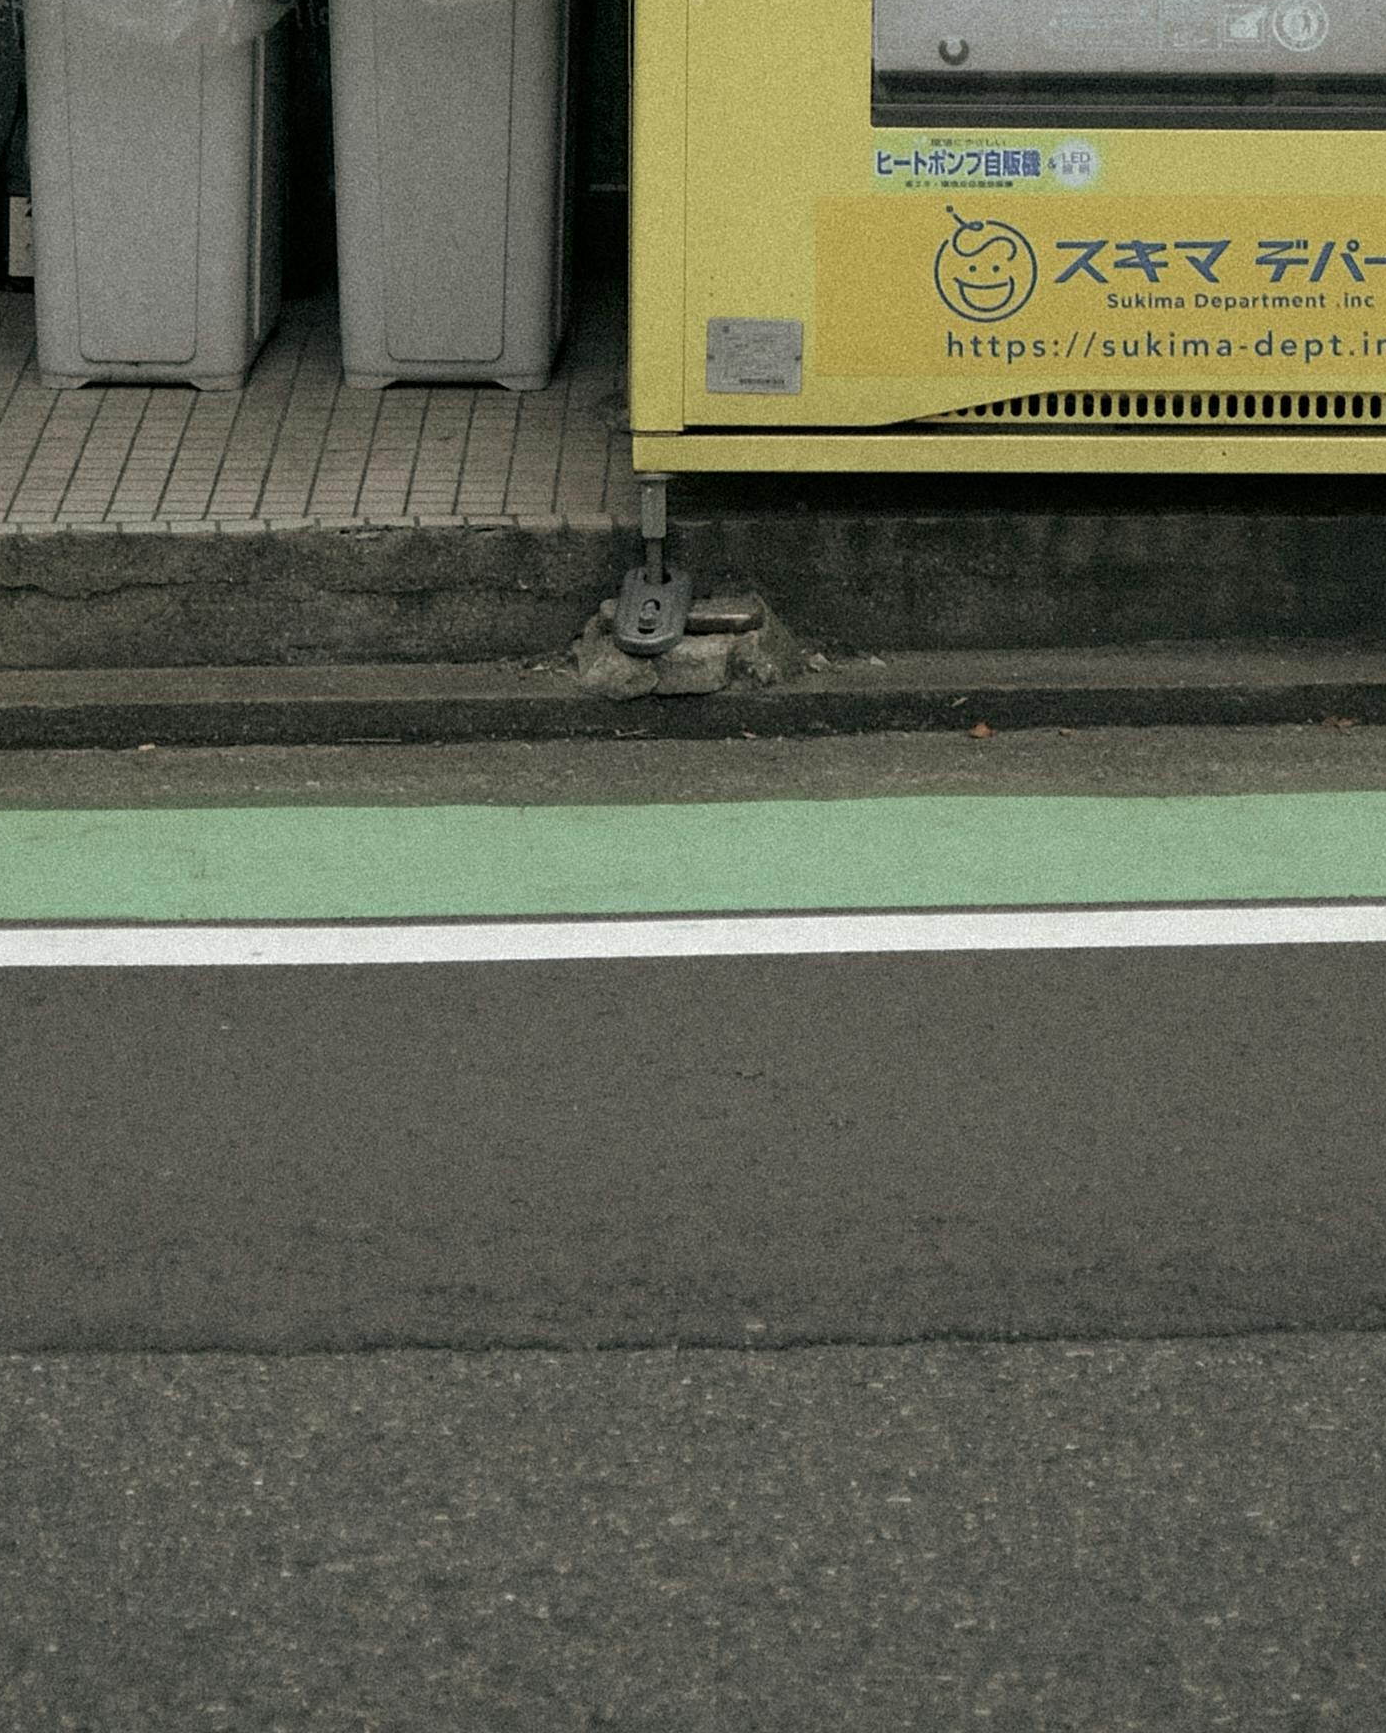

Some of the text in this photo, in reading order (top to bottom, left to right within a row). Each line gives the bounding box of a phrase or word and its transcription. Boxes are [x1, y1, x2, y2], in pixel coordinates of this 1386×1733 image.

[877, 149, 1042, 177] ヒートポンプ自販機
[1053, 239, 1231, 283] スキマ
[1107, 291, 1185, 310] Sukima
[1194, 291, 1327, 313] Department
